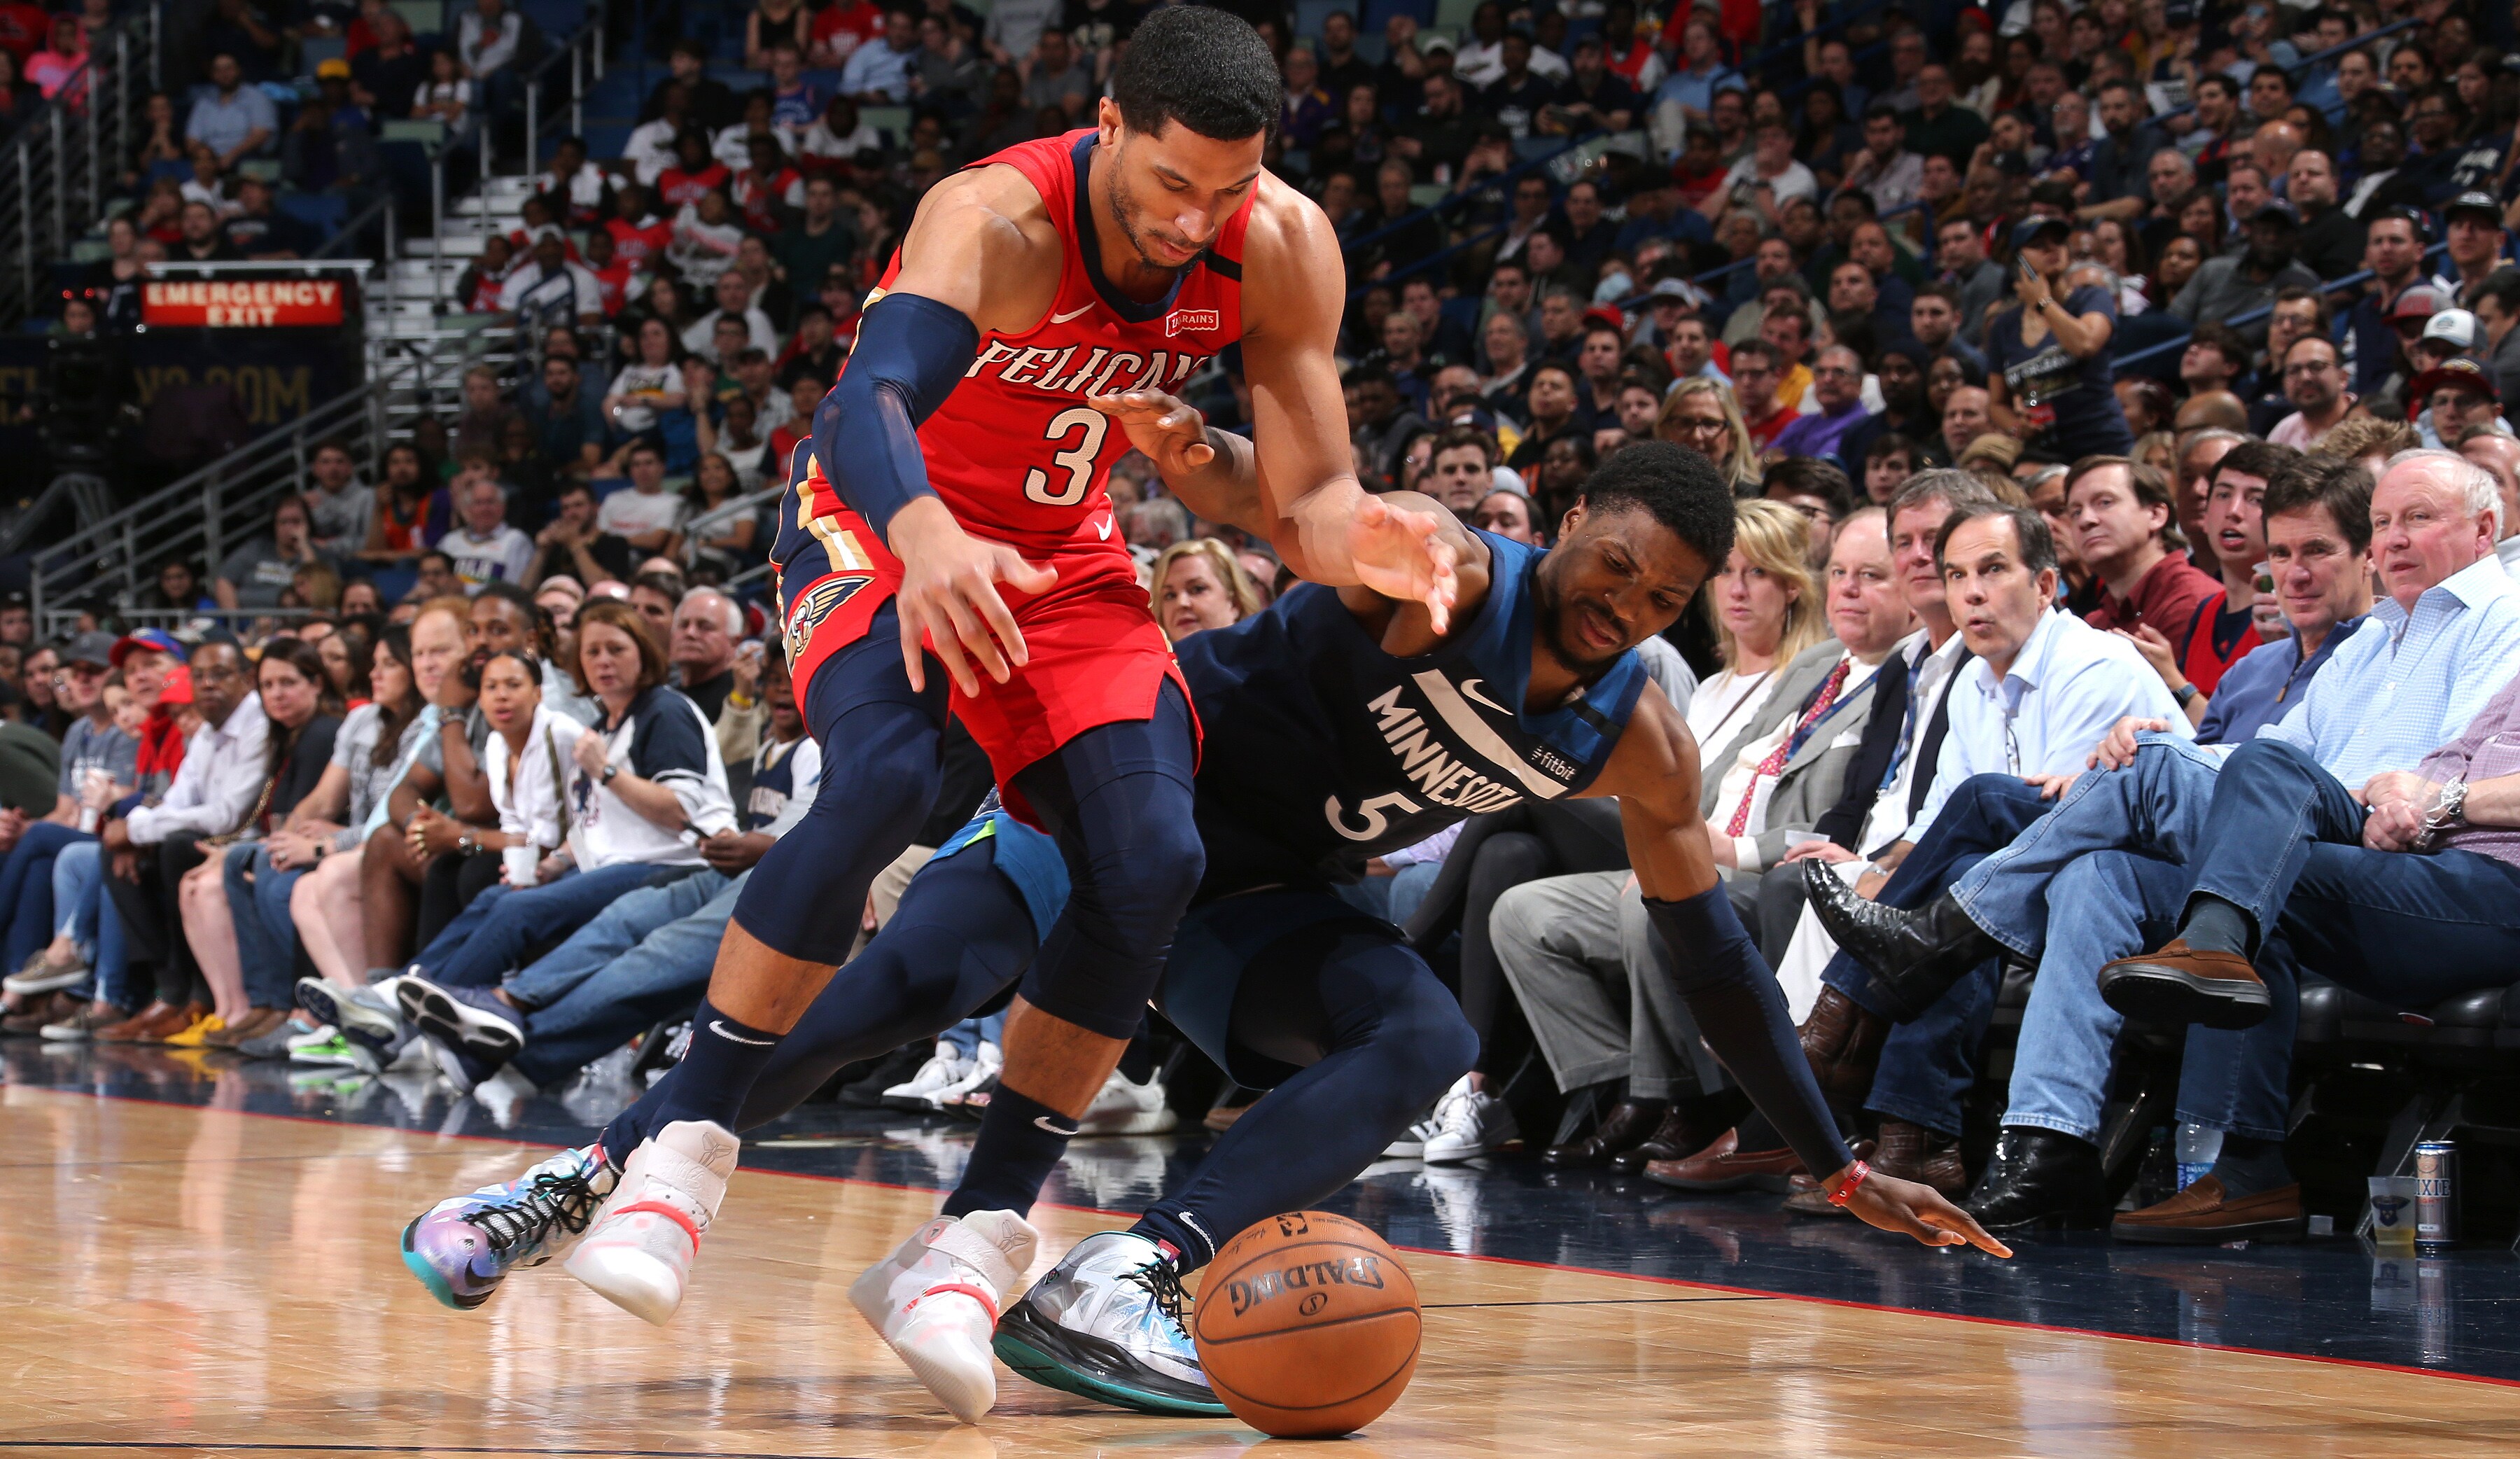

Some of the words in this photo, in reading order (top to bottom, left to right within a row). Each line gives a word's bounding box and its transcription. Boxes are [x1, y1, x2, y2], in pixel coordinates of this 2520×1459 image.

[146, 281, 337, 306] EMERGENCY
[206, 307, 279, 326] EXIT
[1023, 404, 1109, 508] 3
[1367, 685, 1524, 815] MINNESOTA
[1540, 751, 1577, 781] fitbit
[1324, 791, 1423, 841] 5
[2414, 1178, 2451, 1196] IXIE
[1228, 1257, 1384, 1318] SPALDING
